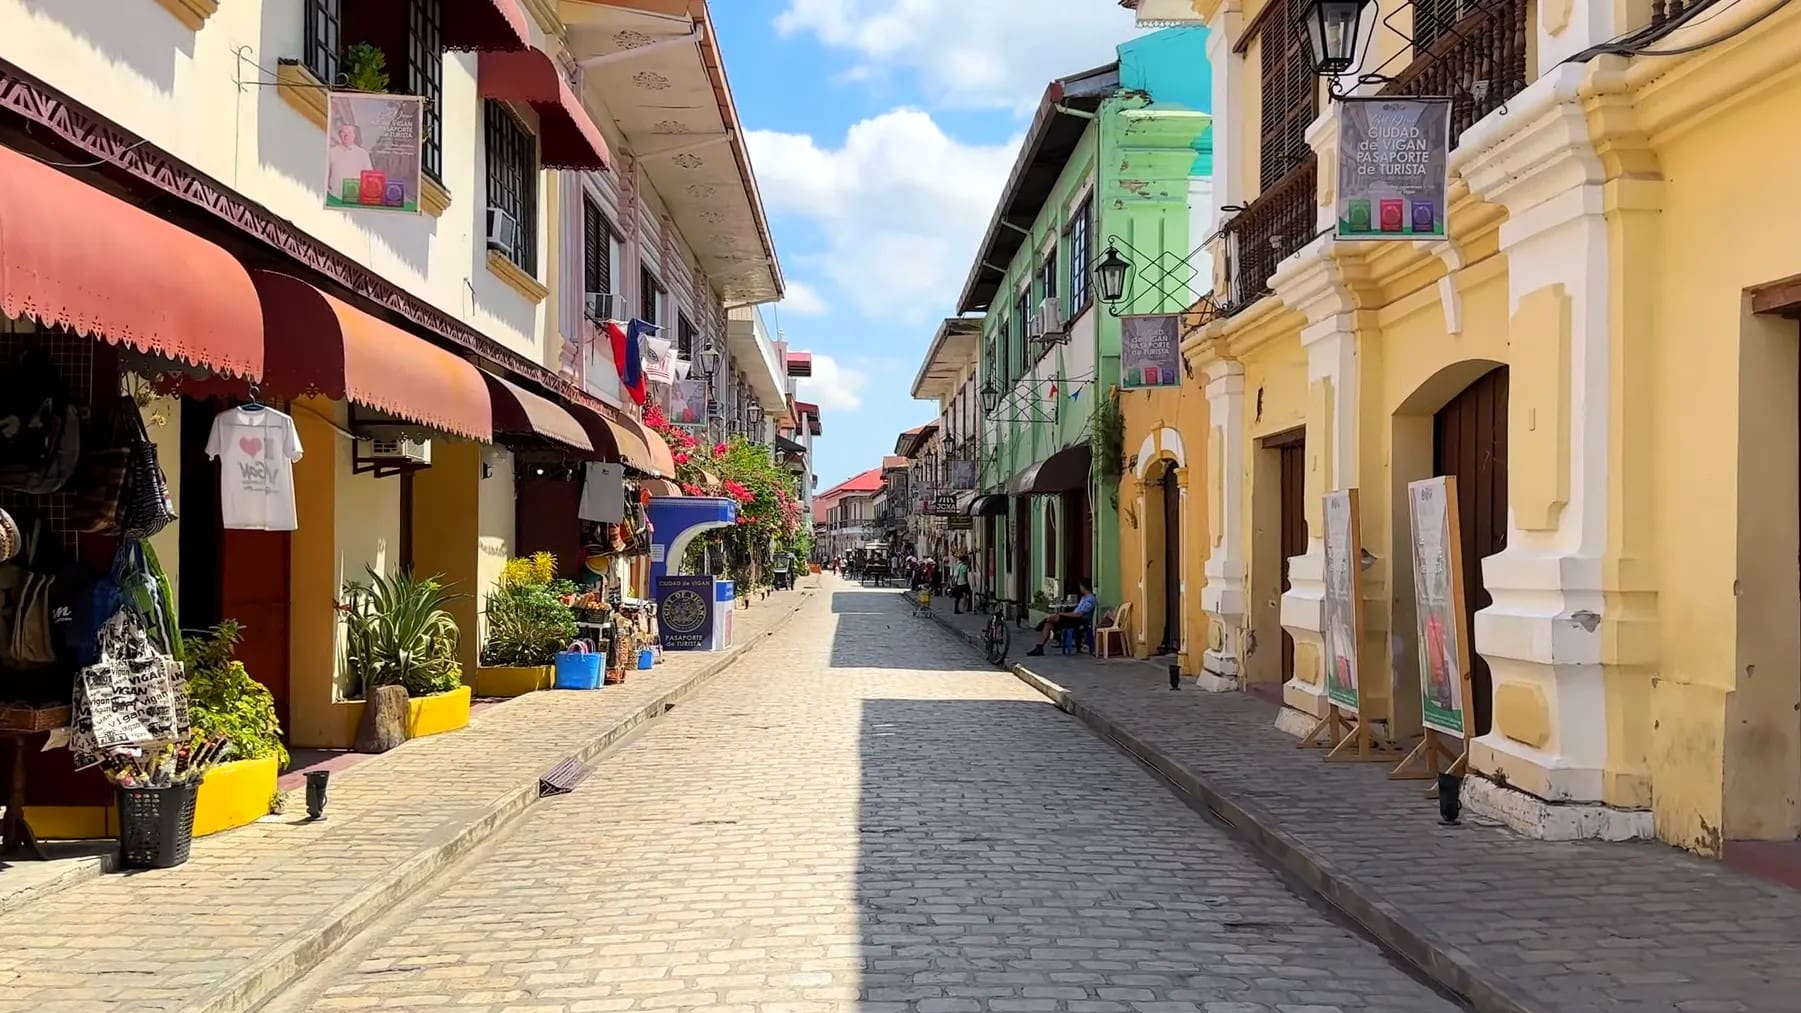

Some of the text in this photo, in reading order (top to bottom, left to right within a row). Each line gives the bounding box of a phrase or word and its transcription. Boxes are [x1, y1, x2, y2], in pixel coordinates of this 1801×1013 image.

[1368, 127, 1419, 138] CIUDAD
[1360, 139, 1427, 150] de VIGAN
[1357, 152, 1429, 163] PASAPORTE
[1358, 164, 1426, 175] de TURISTA
[112, 686, 148, 696] VIGAN
